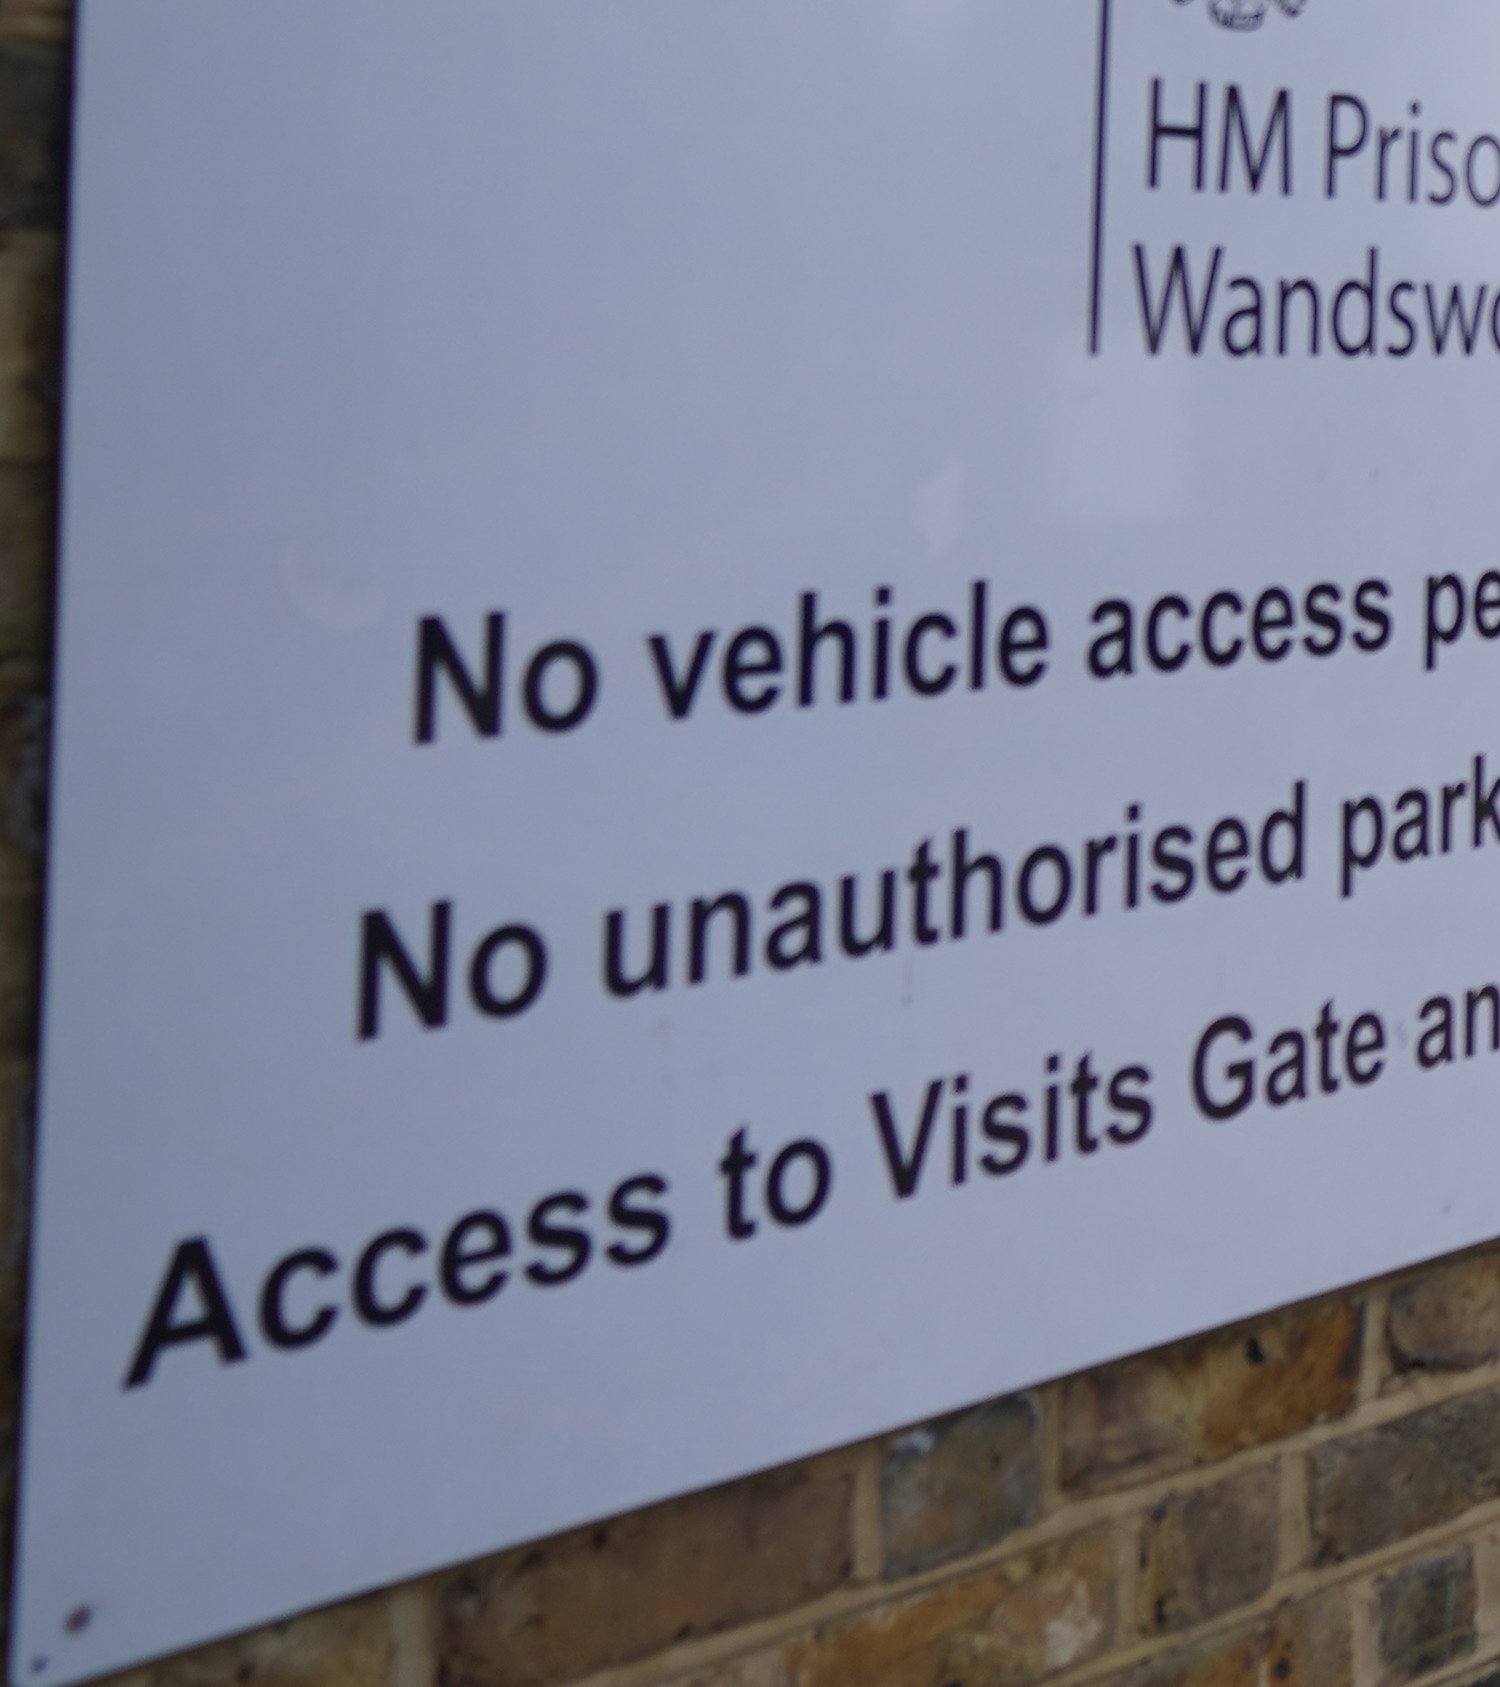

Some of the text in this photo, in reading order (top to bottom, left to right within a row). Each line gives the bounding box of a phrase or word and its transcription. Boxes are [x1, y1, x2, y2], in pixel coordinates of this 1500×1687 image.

[1148, 77, 1291, 196] HM
[413, 610, 599, 746] No
[647, 580, 1050, 721] vehicle
[1086, 578, 1393, 680] access
[356, 899, 548, 1041] No
[603, 779, 1306, 999] unauthorised
[123, 1173, 671, 1390] Access
[719, 1127, 832, 1241] to
[869, 1053, 1154, 1200] Visits
[1191, 1001, 1386, 1122] Gate
